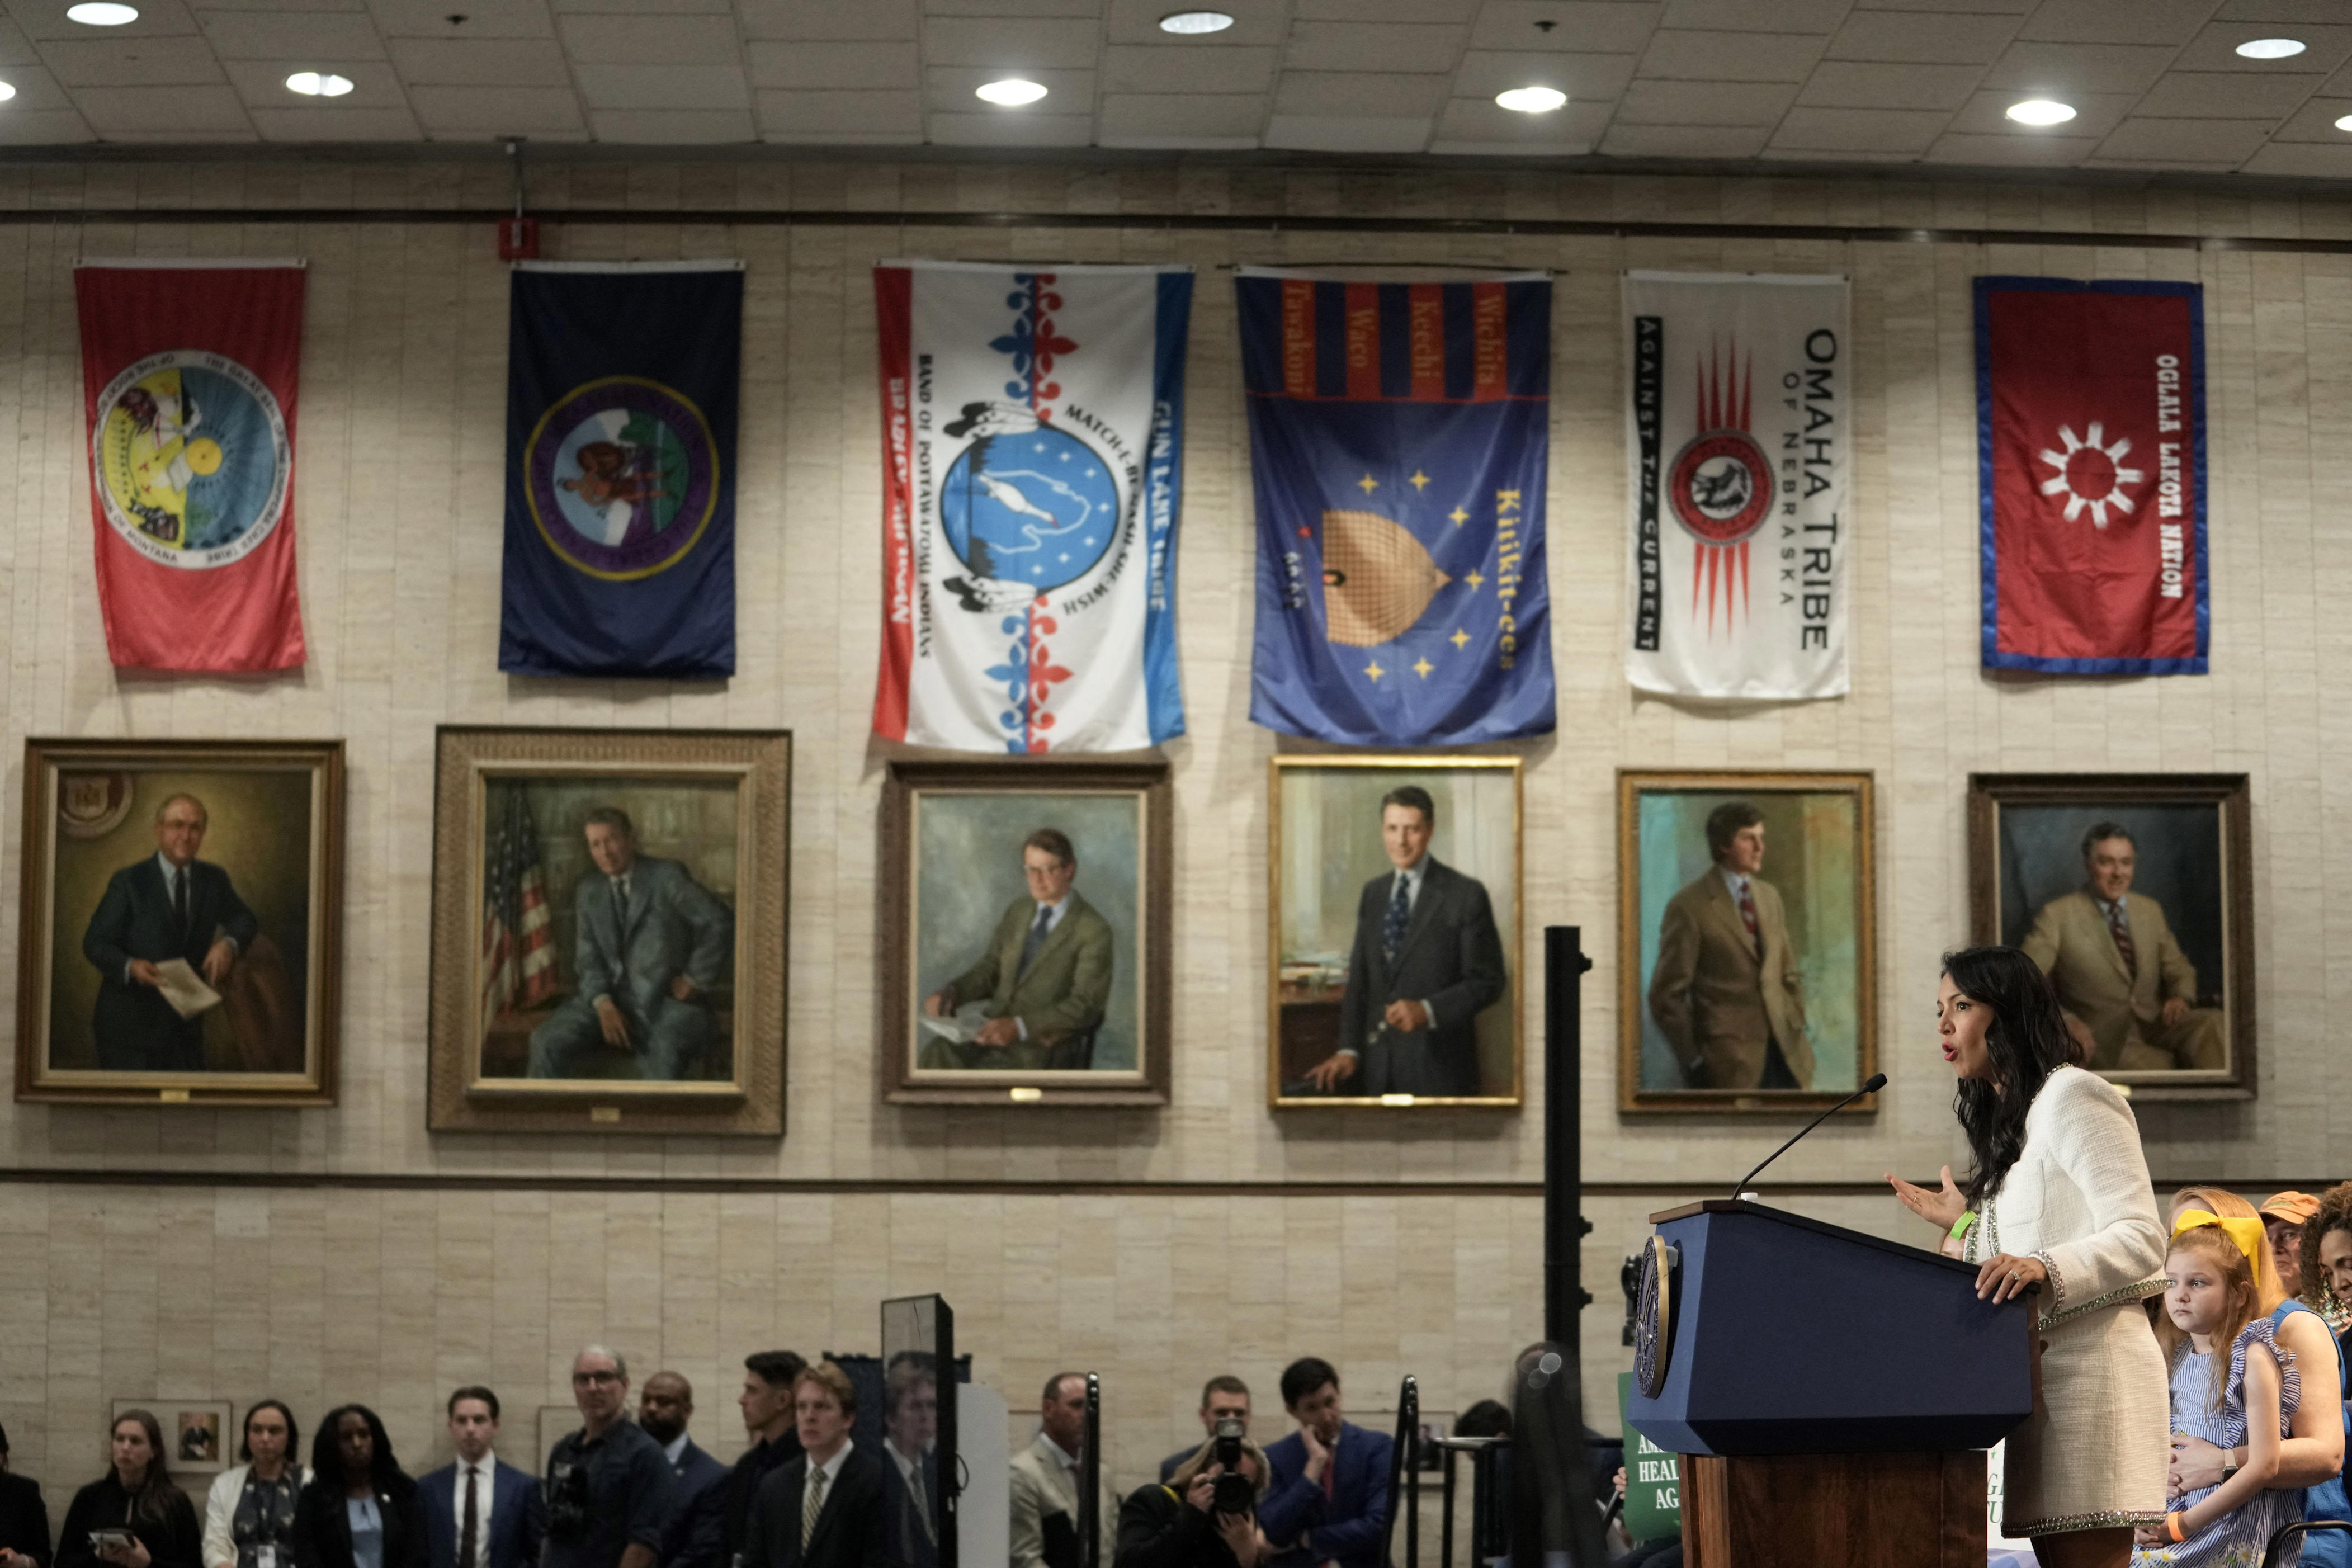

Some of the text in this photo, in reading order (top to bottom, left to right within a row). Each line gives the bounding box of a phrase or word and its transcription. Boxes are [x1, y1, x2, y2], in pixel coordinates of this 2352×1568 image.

[1350, 309, 1376, 369] Waco
[1412, 301, 1441, 378] Keechi
[1477, 294, 1504, 385] Wichita
[918, 354, 933, 402] BAND
[1640, 320, 1657, 438] AGAINST
[919, 410, 933, 432] OF
[1152, 400, 1172, 460] GUN
[1151, 465, 1172, 532] LAKE
[1780, 372, 1800, 605] OF NEBRASKA
[1801, 329, 1838, 651] OMAHA TRIBE
[2155, 354, 2184, 598] OGLALA LAKOTA NATION
[919, 582, 932, 658] INDIANS
[1637, 521, 1656, 647] CURRENT
